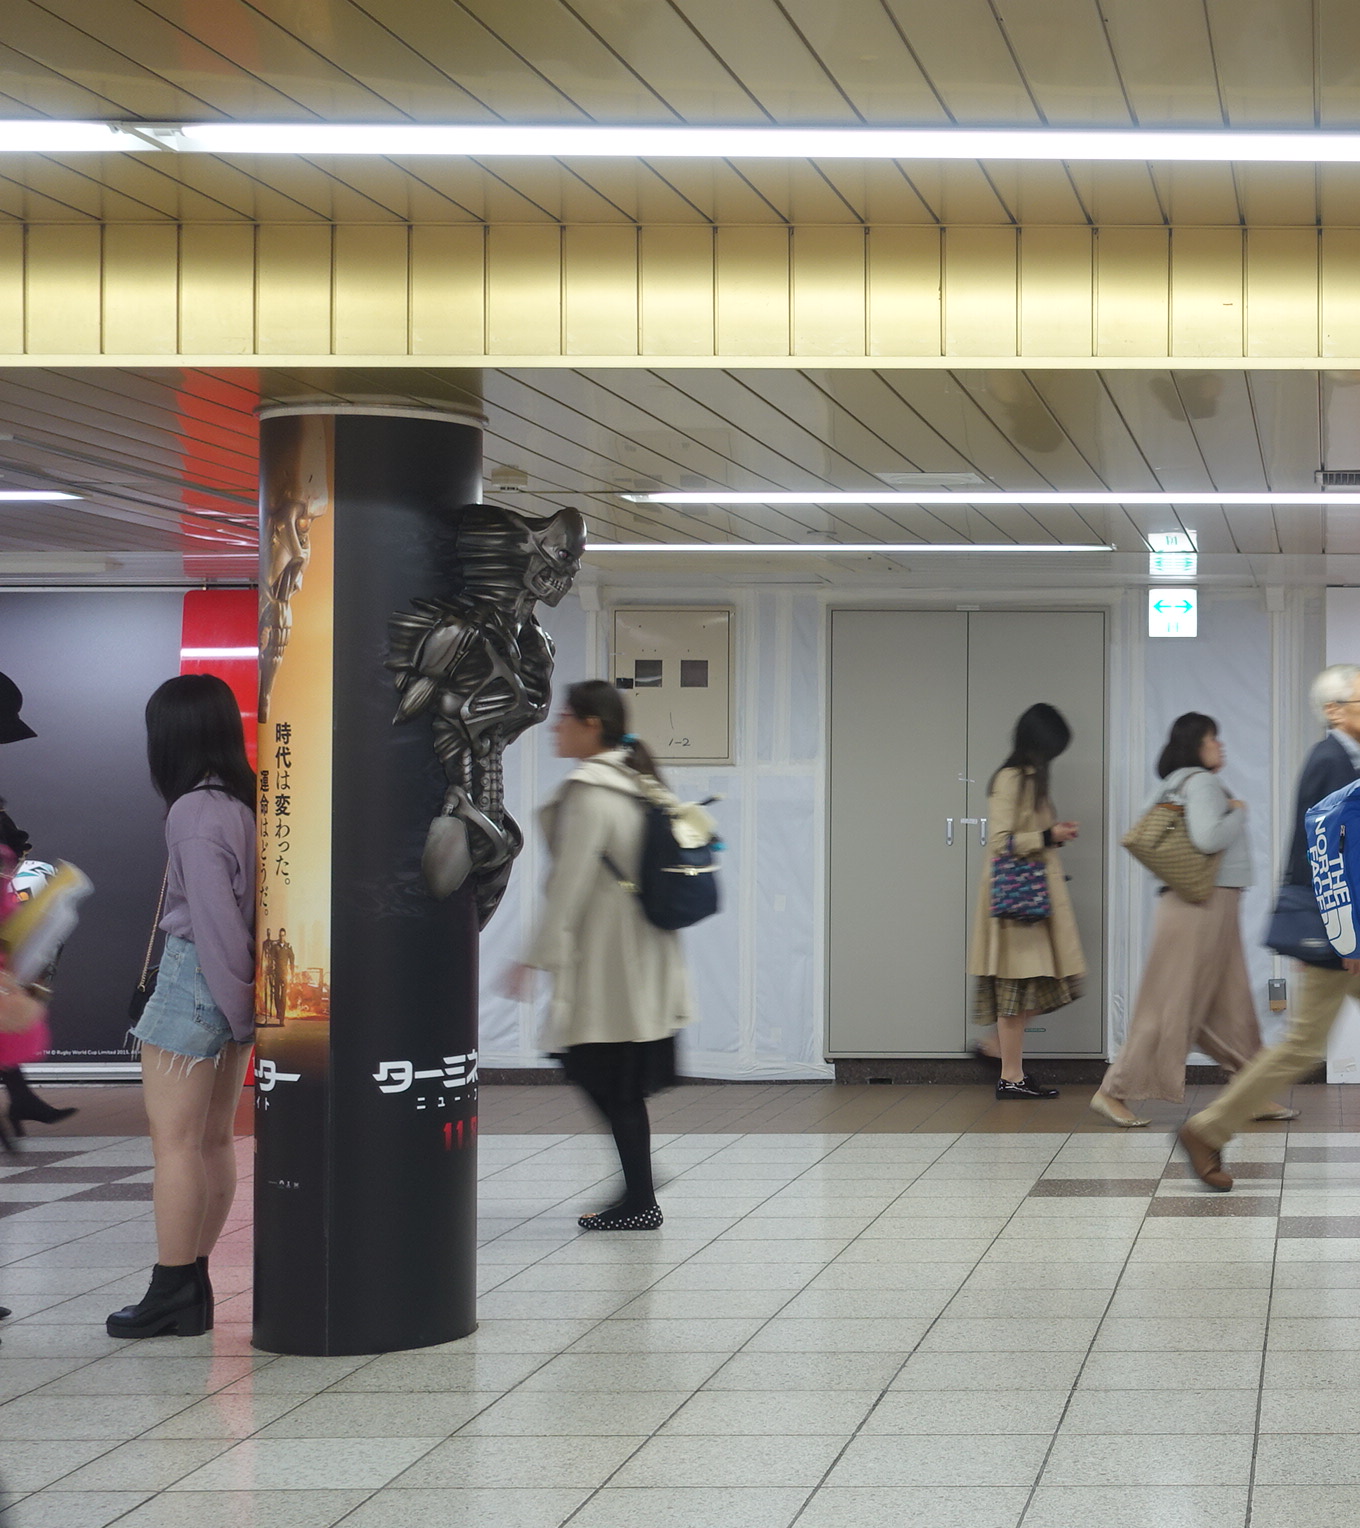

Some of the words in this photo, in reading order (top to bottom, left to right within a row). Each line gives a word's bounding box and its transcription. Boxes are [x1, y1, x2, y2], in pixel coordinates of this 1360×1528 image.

[259, 770, 270, 917] 運命はどうだ。
[275, 721, 292, 886] 時代は変わった。
[1309, 844, 1327, 911] FACE
[1314, 815, 1337, 911] NORTH
[1329, 852, 1351, 906] THE
